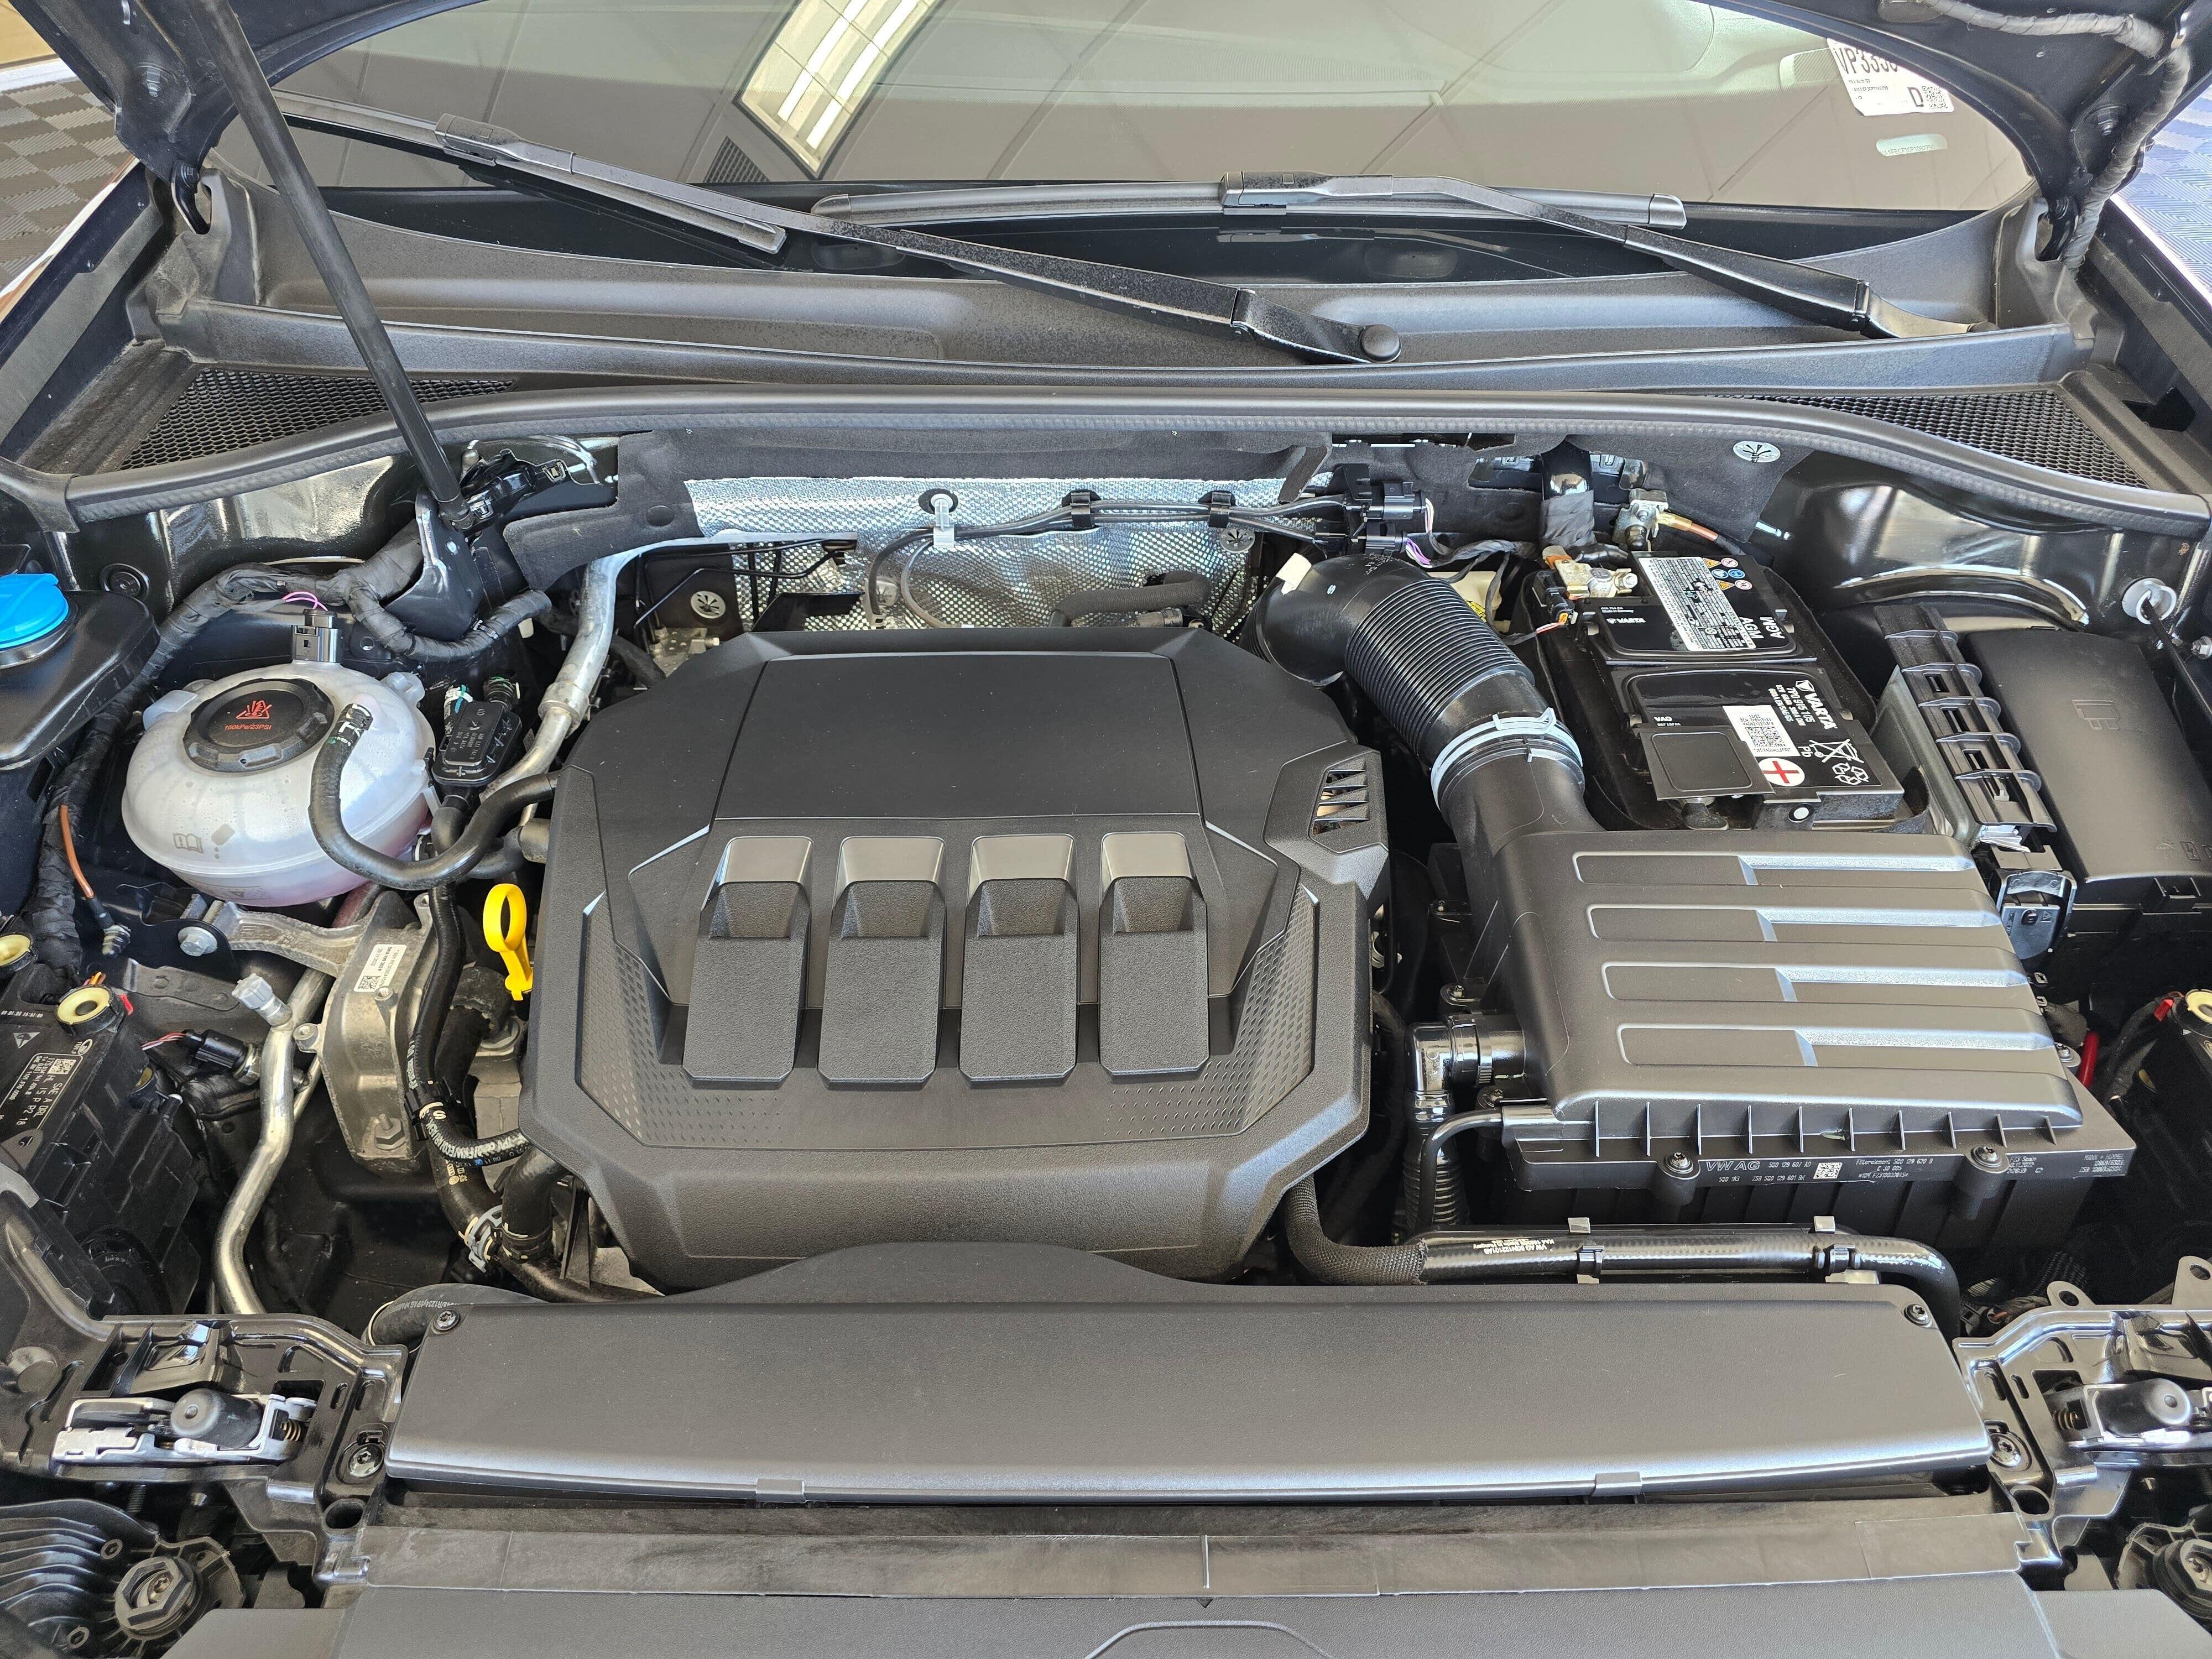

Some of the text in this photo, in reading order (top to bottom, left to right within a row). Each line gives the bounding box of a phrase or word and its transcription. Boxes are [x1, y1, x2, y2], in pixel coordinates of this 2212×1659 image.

[1907, 87, 1924, 107] D
[1739, 617, 1764, 639] AGM
[1760, 617, 1785, 639] AGM
[1804, 693, 1838, 729] VARTA
[1798, 746, 1813, 758] Pb
[48, 1083, 62, 1095] SAE
[33, 1105, 49, 1118] DRL
[16, 1117, 28, 1125] 18
[1706, 1160, 1761, 1171] VW AG
